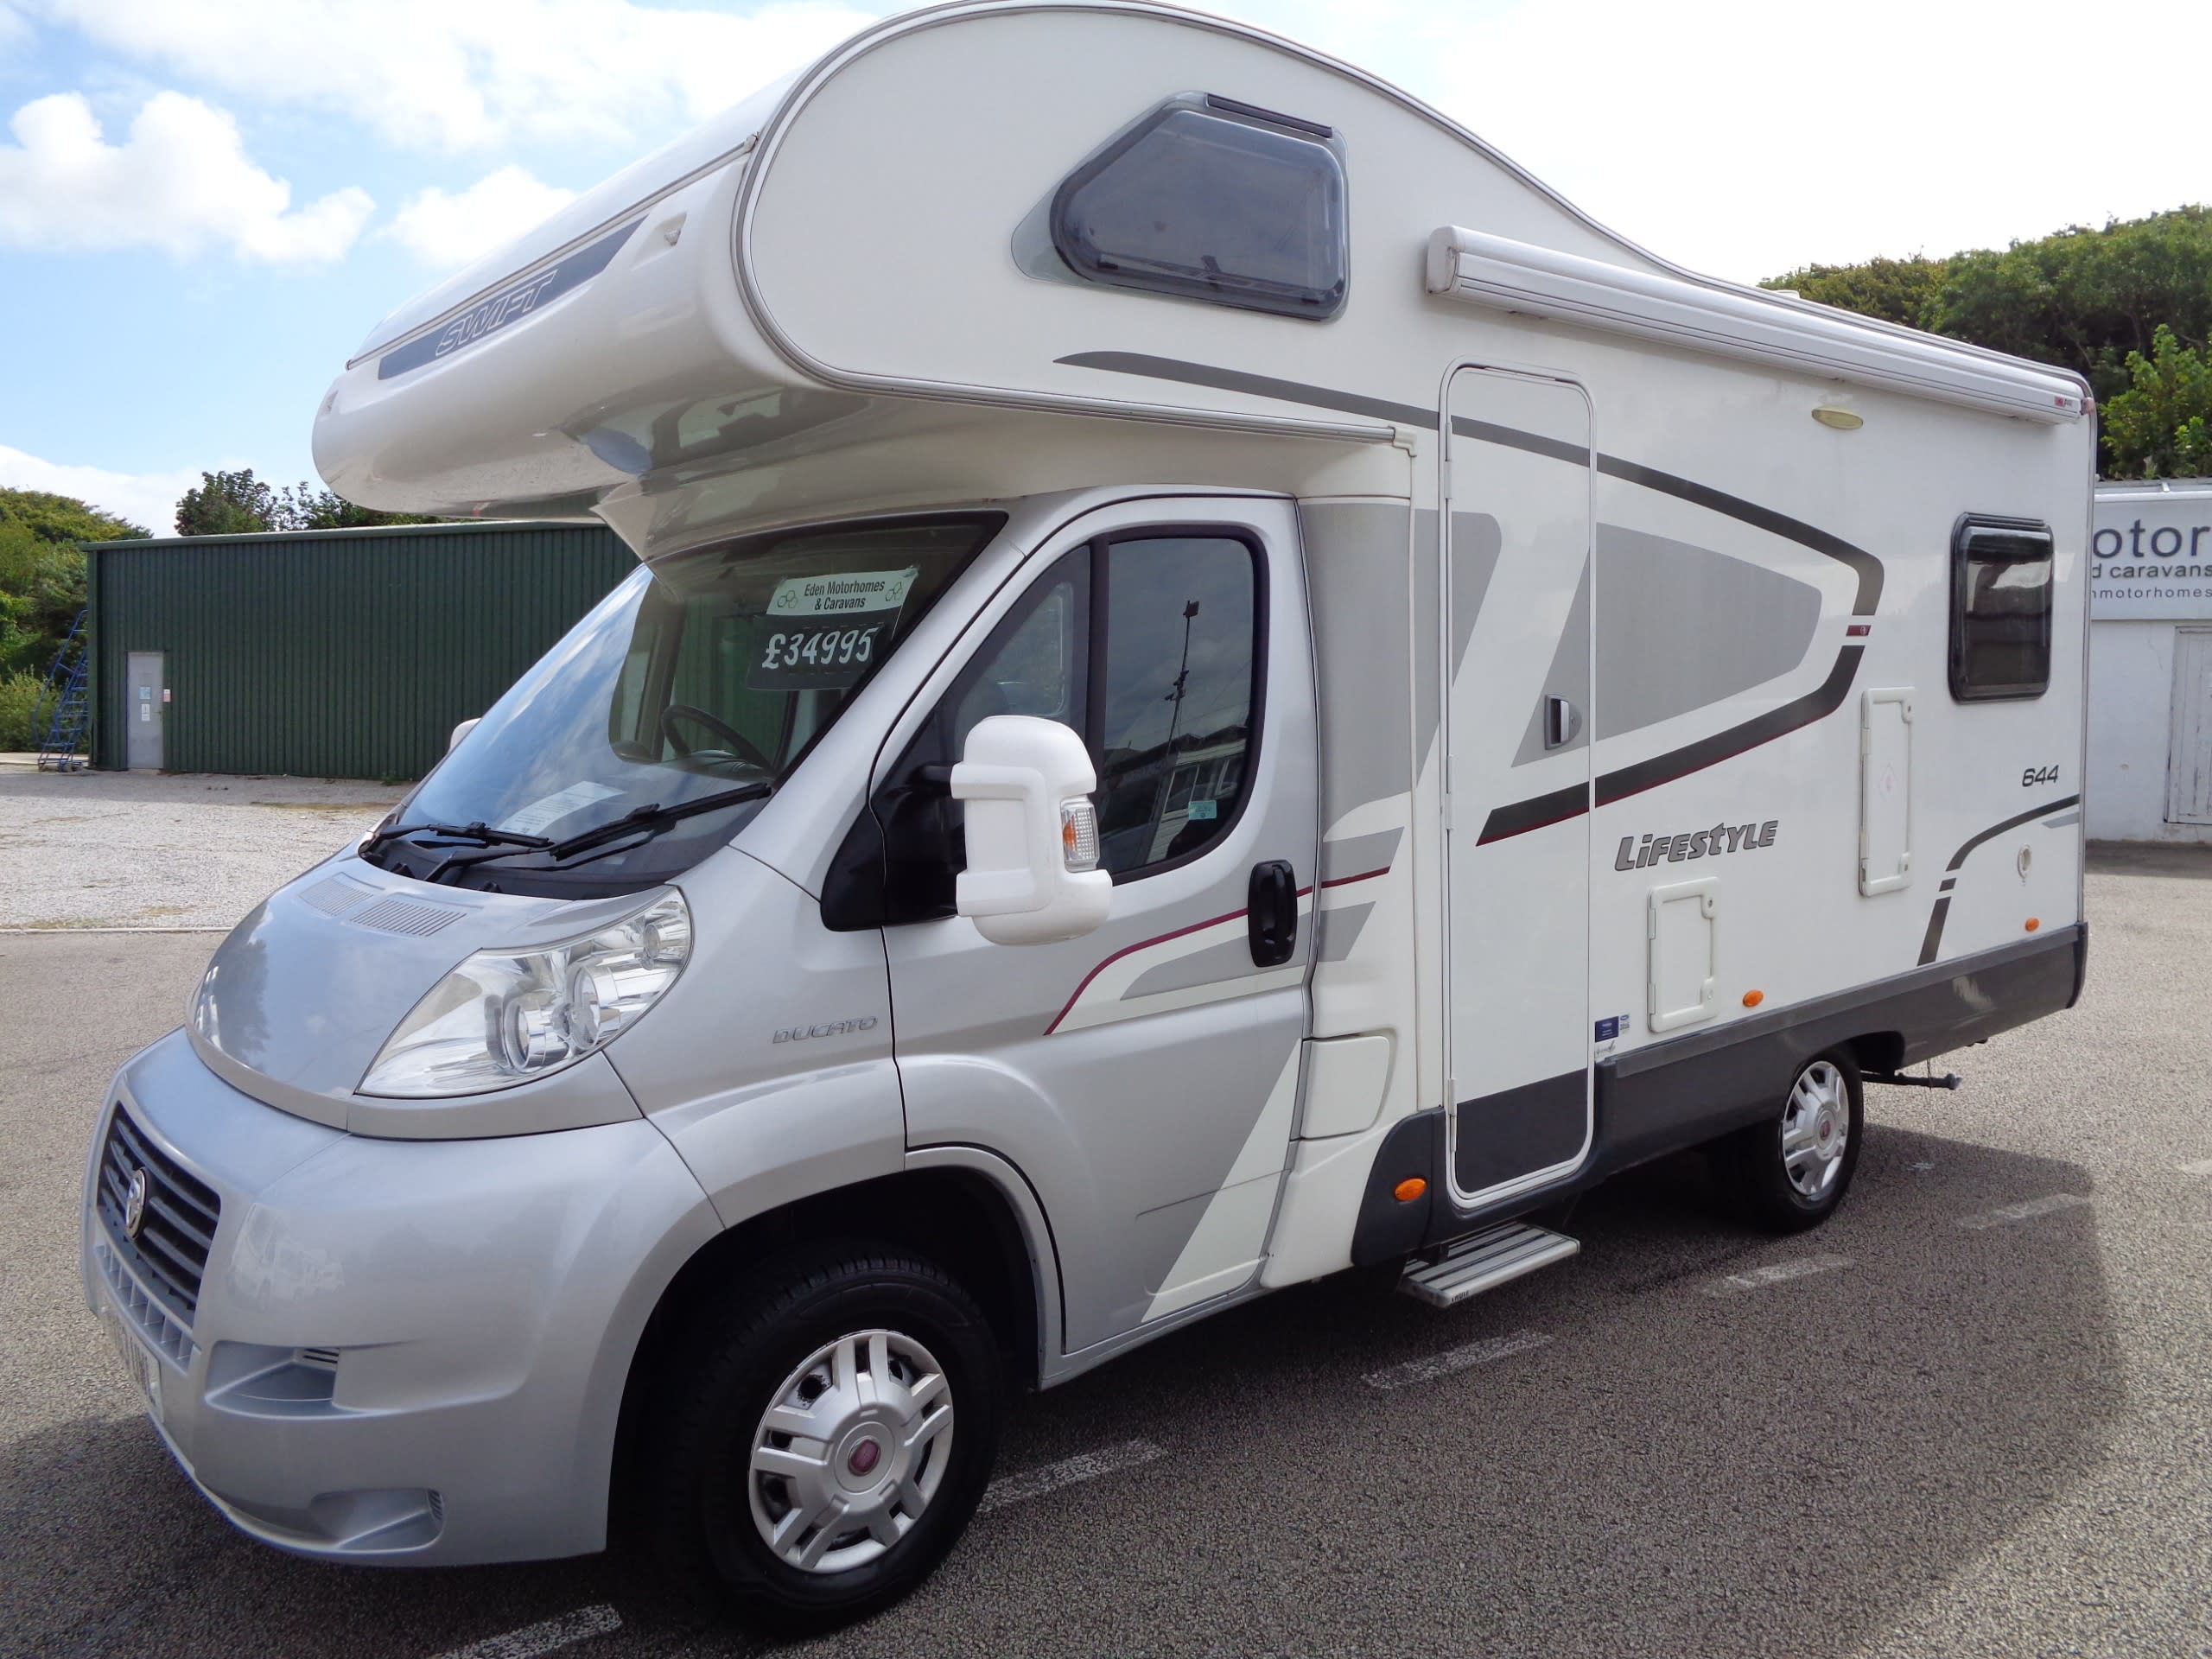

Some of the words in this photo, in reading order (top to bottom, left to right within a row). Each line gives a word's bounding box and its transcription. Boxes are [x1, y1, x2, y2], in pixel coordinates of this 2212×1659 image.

[435, 268, 559, 357] SWIFT
[2109, 564, 2212, 579] caravans
[804, 583, 824, 597] Eden
[827, 580, 886, 594] Motorhomes
[814, 598, 823, 610] &
[823, 597, 867, 610] Caravans
[761, 626, 880, 670] £34995
[2021, 765, 2060, 787] 644
[772, 1015, 879, 1045] DUCATO
